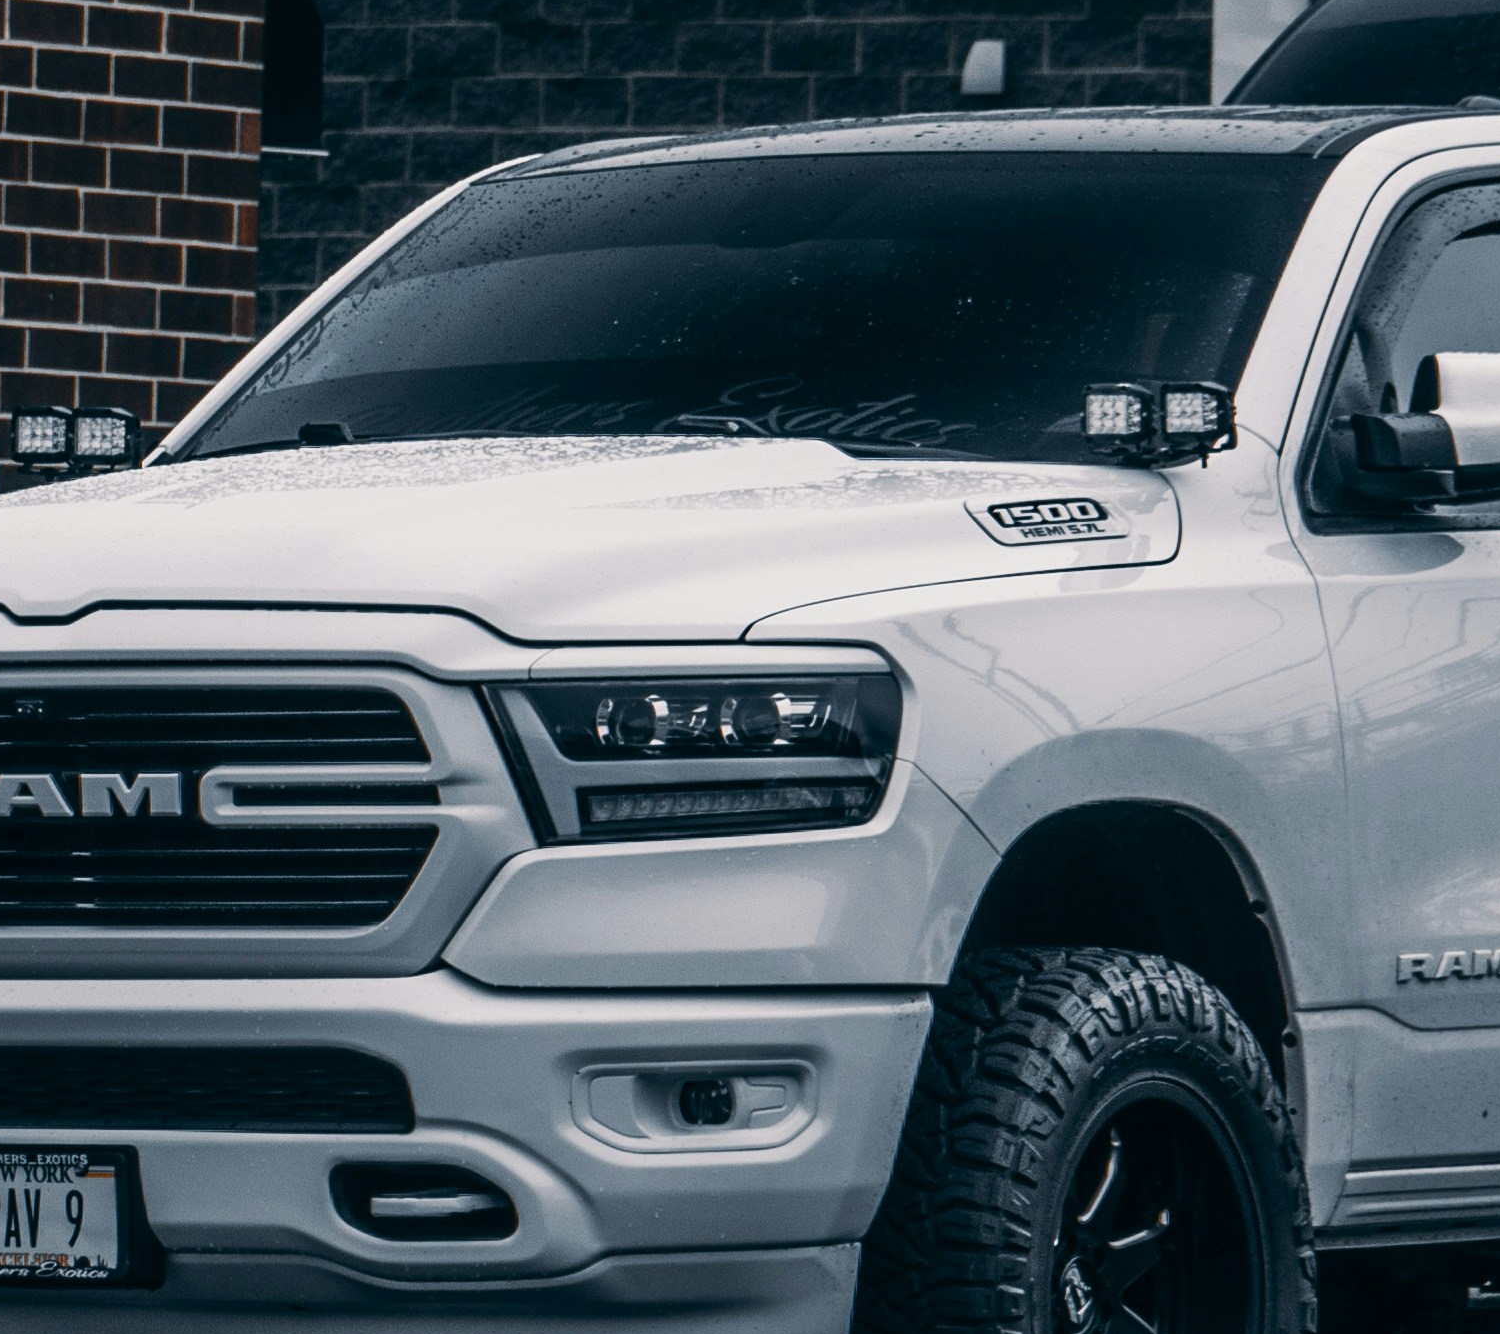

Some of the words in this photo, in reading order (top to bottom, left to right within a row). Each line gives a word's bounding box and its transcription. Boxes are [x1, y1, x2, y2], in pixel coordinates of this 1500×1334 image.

[992, 501, 1100, 526] 1500
[1020, 526, 1065, 538] HEMI
[1067, 523, 1105, 535] 5.7L
[22, 1166, 73, 1184] YORK
[65, 1190, 83, 1248] 9
